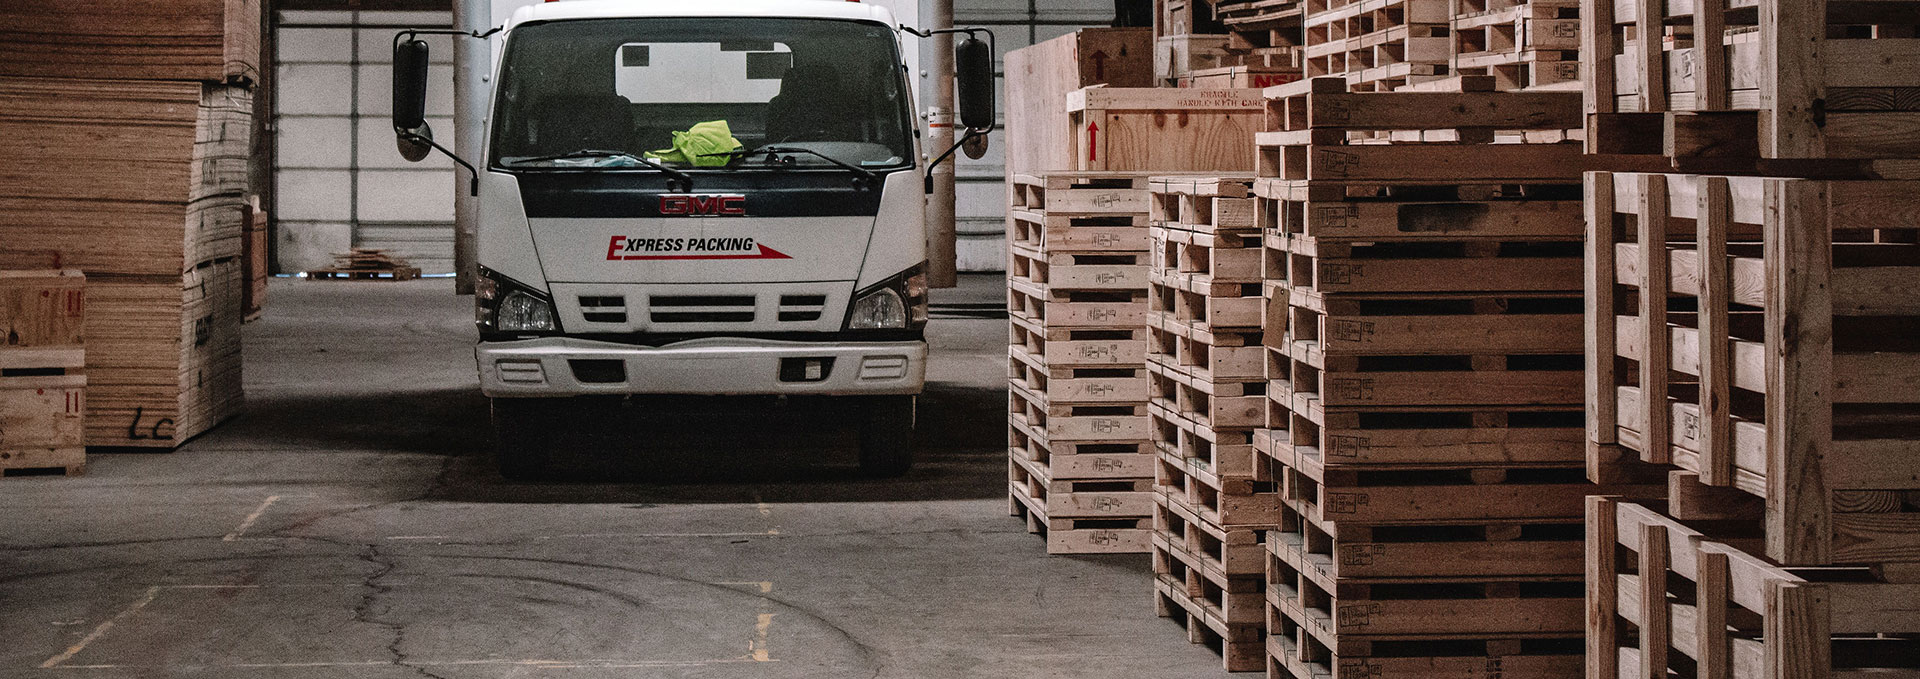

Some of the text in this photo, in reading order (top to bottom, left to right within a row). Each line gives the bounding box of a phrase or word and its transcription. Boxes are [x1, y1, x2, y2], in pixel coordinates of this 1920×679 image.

[1200, 90, 1239, 99] FRAGILE
[1177, 99, 1264, 107] HANDLE WITH CARE
[660, 196, 745, 215] GMC
[606, 235, 753, 261] EXPRESS PACKING
